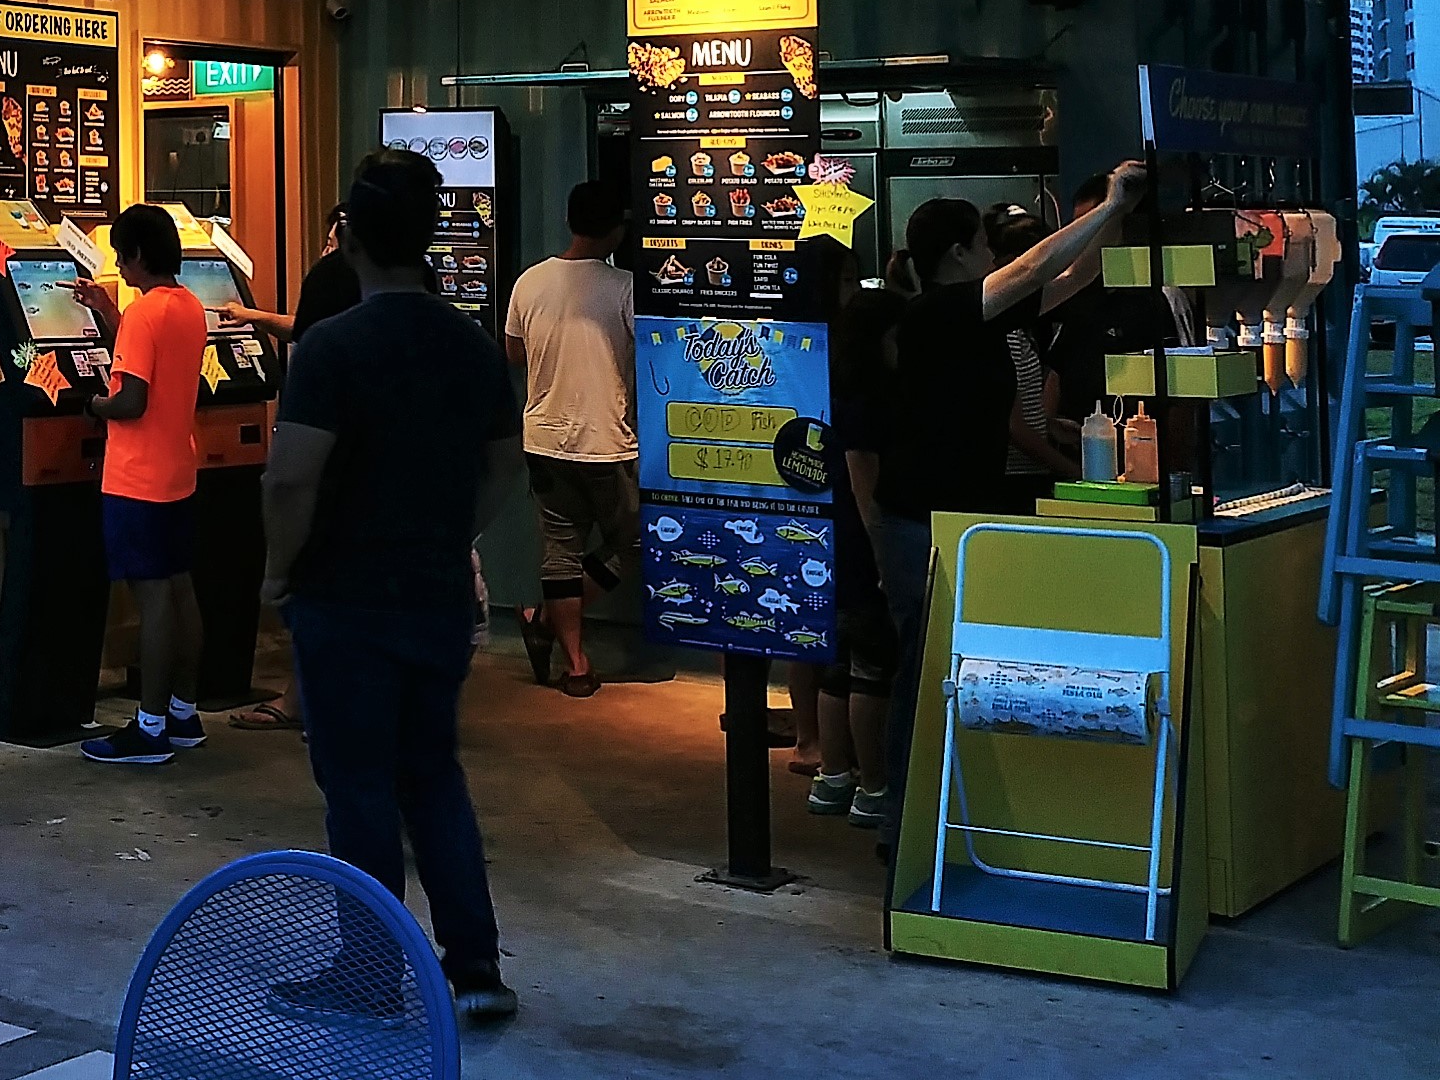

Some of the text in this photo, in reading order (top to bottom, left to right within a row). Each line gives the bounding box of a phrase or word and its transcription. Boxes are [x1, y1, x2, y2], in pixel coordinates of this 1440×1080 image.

[5, 10, 72, 37] ORDERING
[75, 17, 109, 40] HERE
[691, 38, 753, 68] MENU
[684, 328, 760, 368] Today's
[710, 356, 776, 388] Catch
[685, 406, 742, 433] COD
[782, 456, 828, 484] LEMONADE
